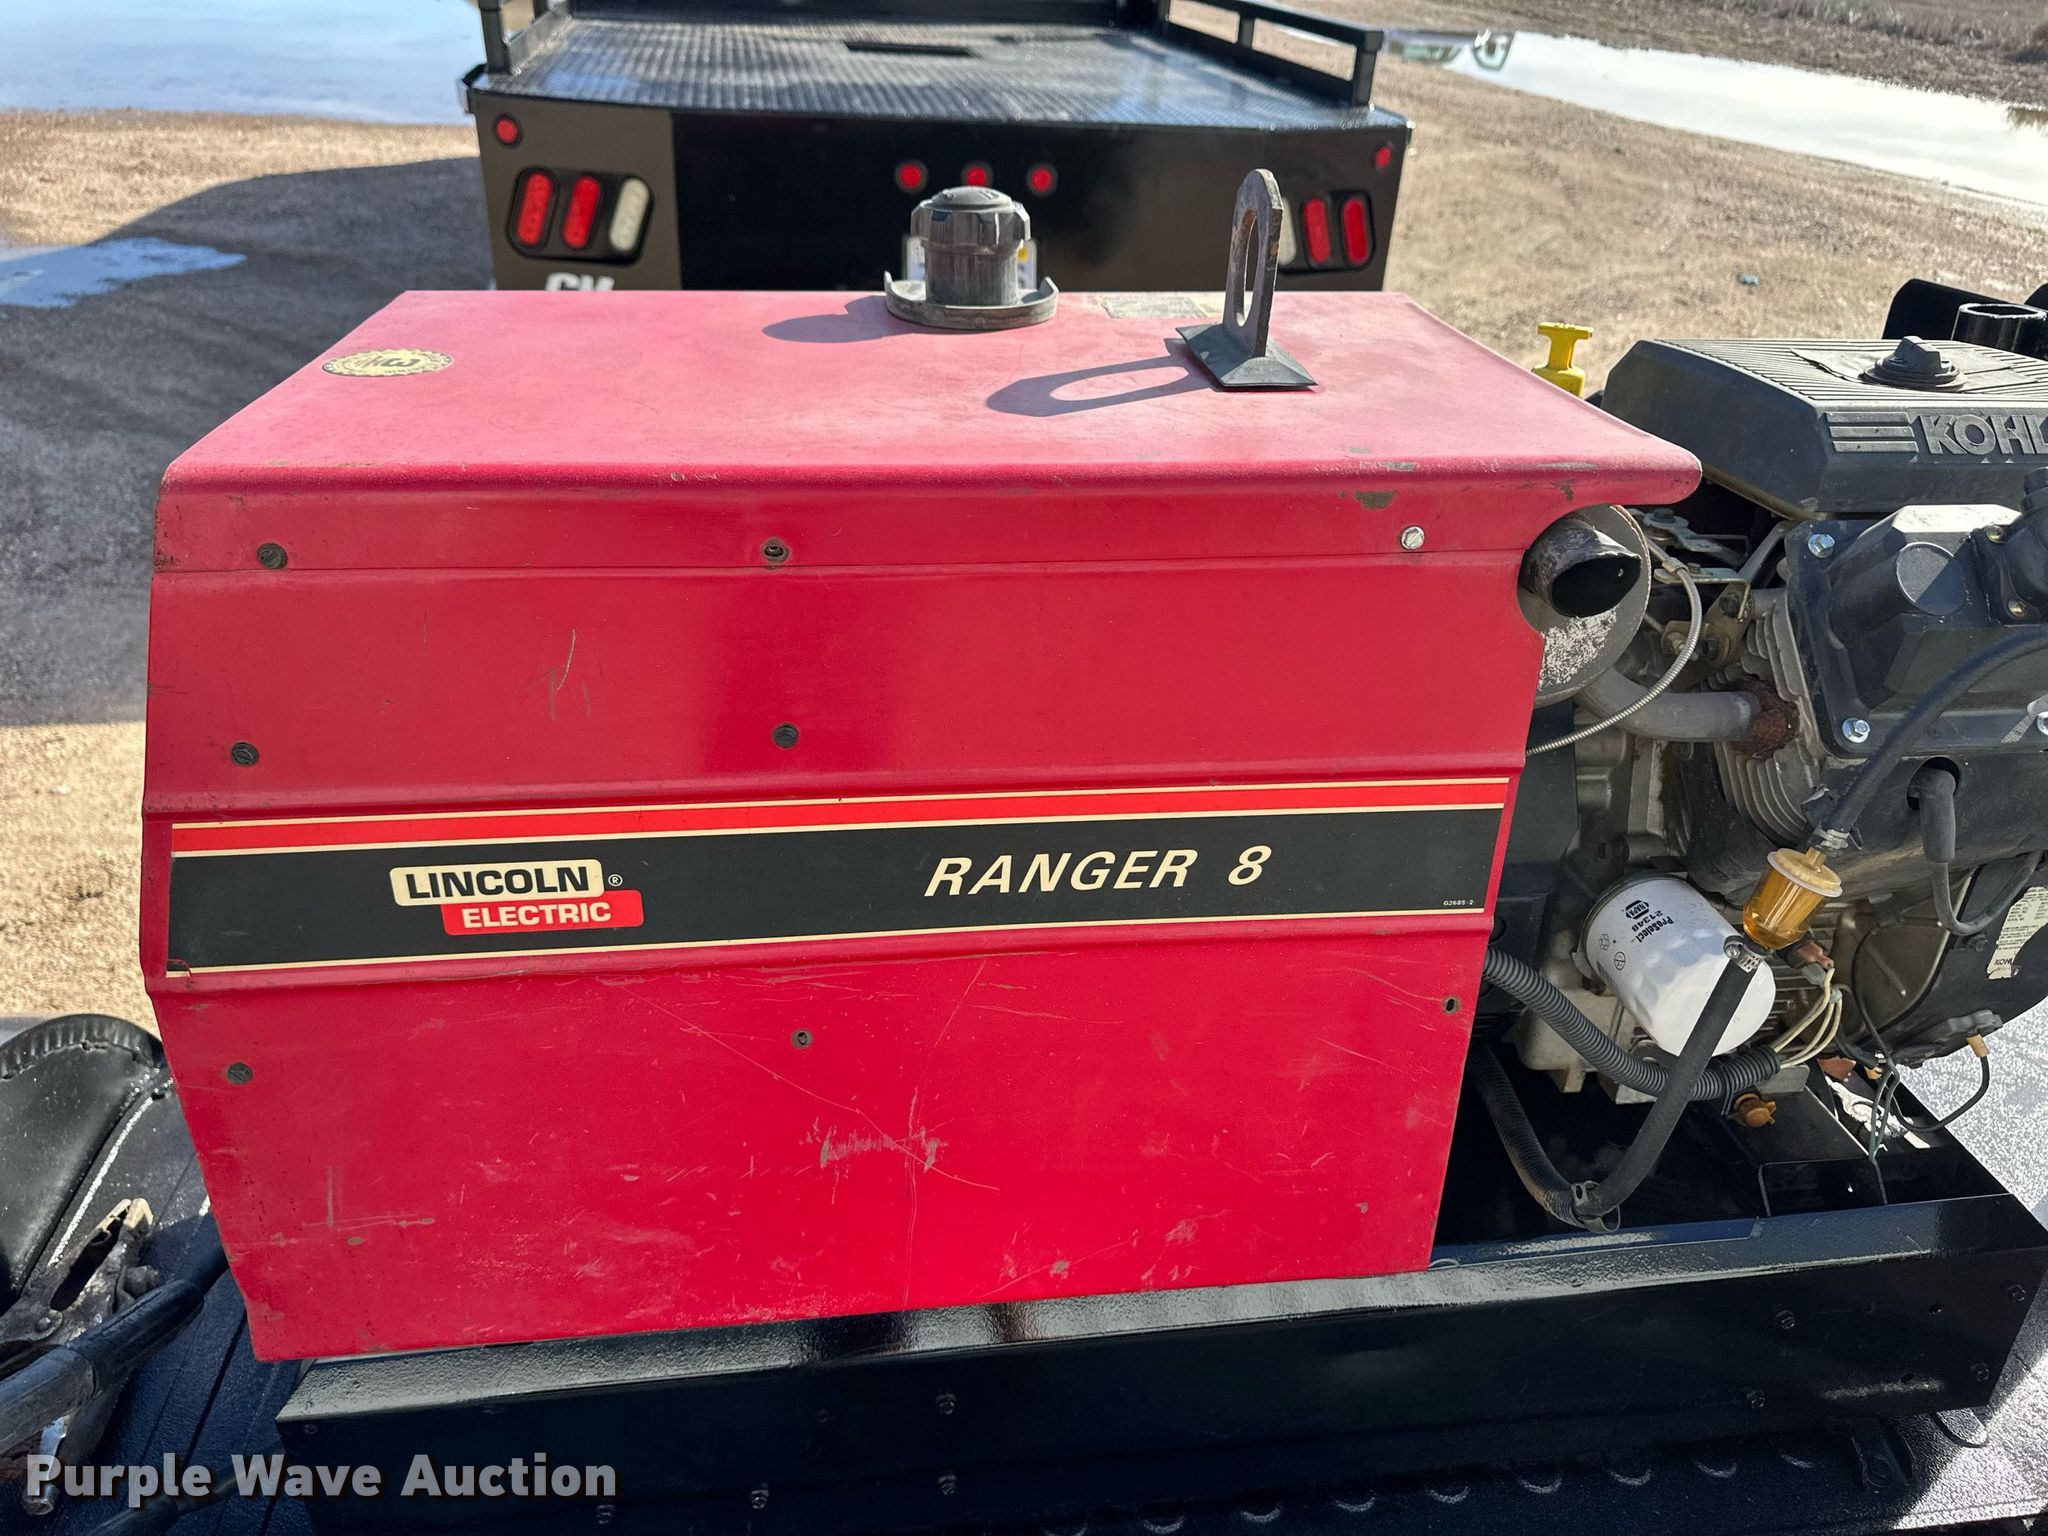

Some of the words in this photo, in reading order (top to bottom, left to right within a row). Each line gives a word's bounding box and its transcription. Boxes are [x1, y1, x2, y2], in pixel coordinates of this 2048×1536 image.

[405, 866, 590, 899] LINCOLN
[924, 849, 1198, 897] RANGER
[1228, 845, 1272, 886] 8
[461, 902, 612, 929] ELECTRIC
[1628, 902, 1647, 917] NAPA
[1631, 910, 1664, 932] 21348
[1635, 916, 1674, 943] ProSelect
